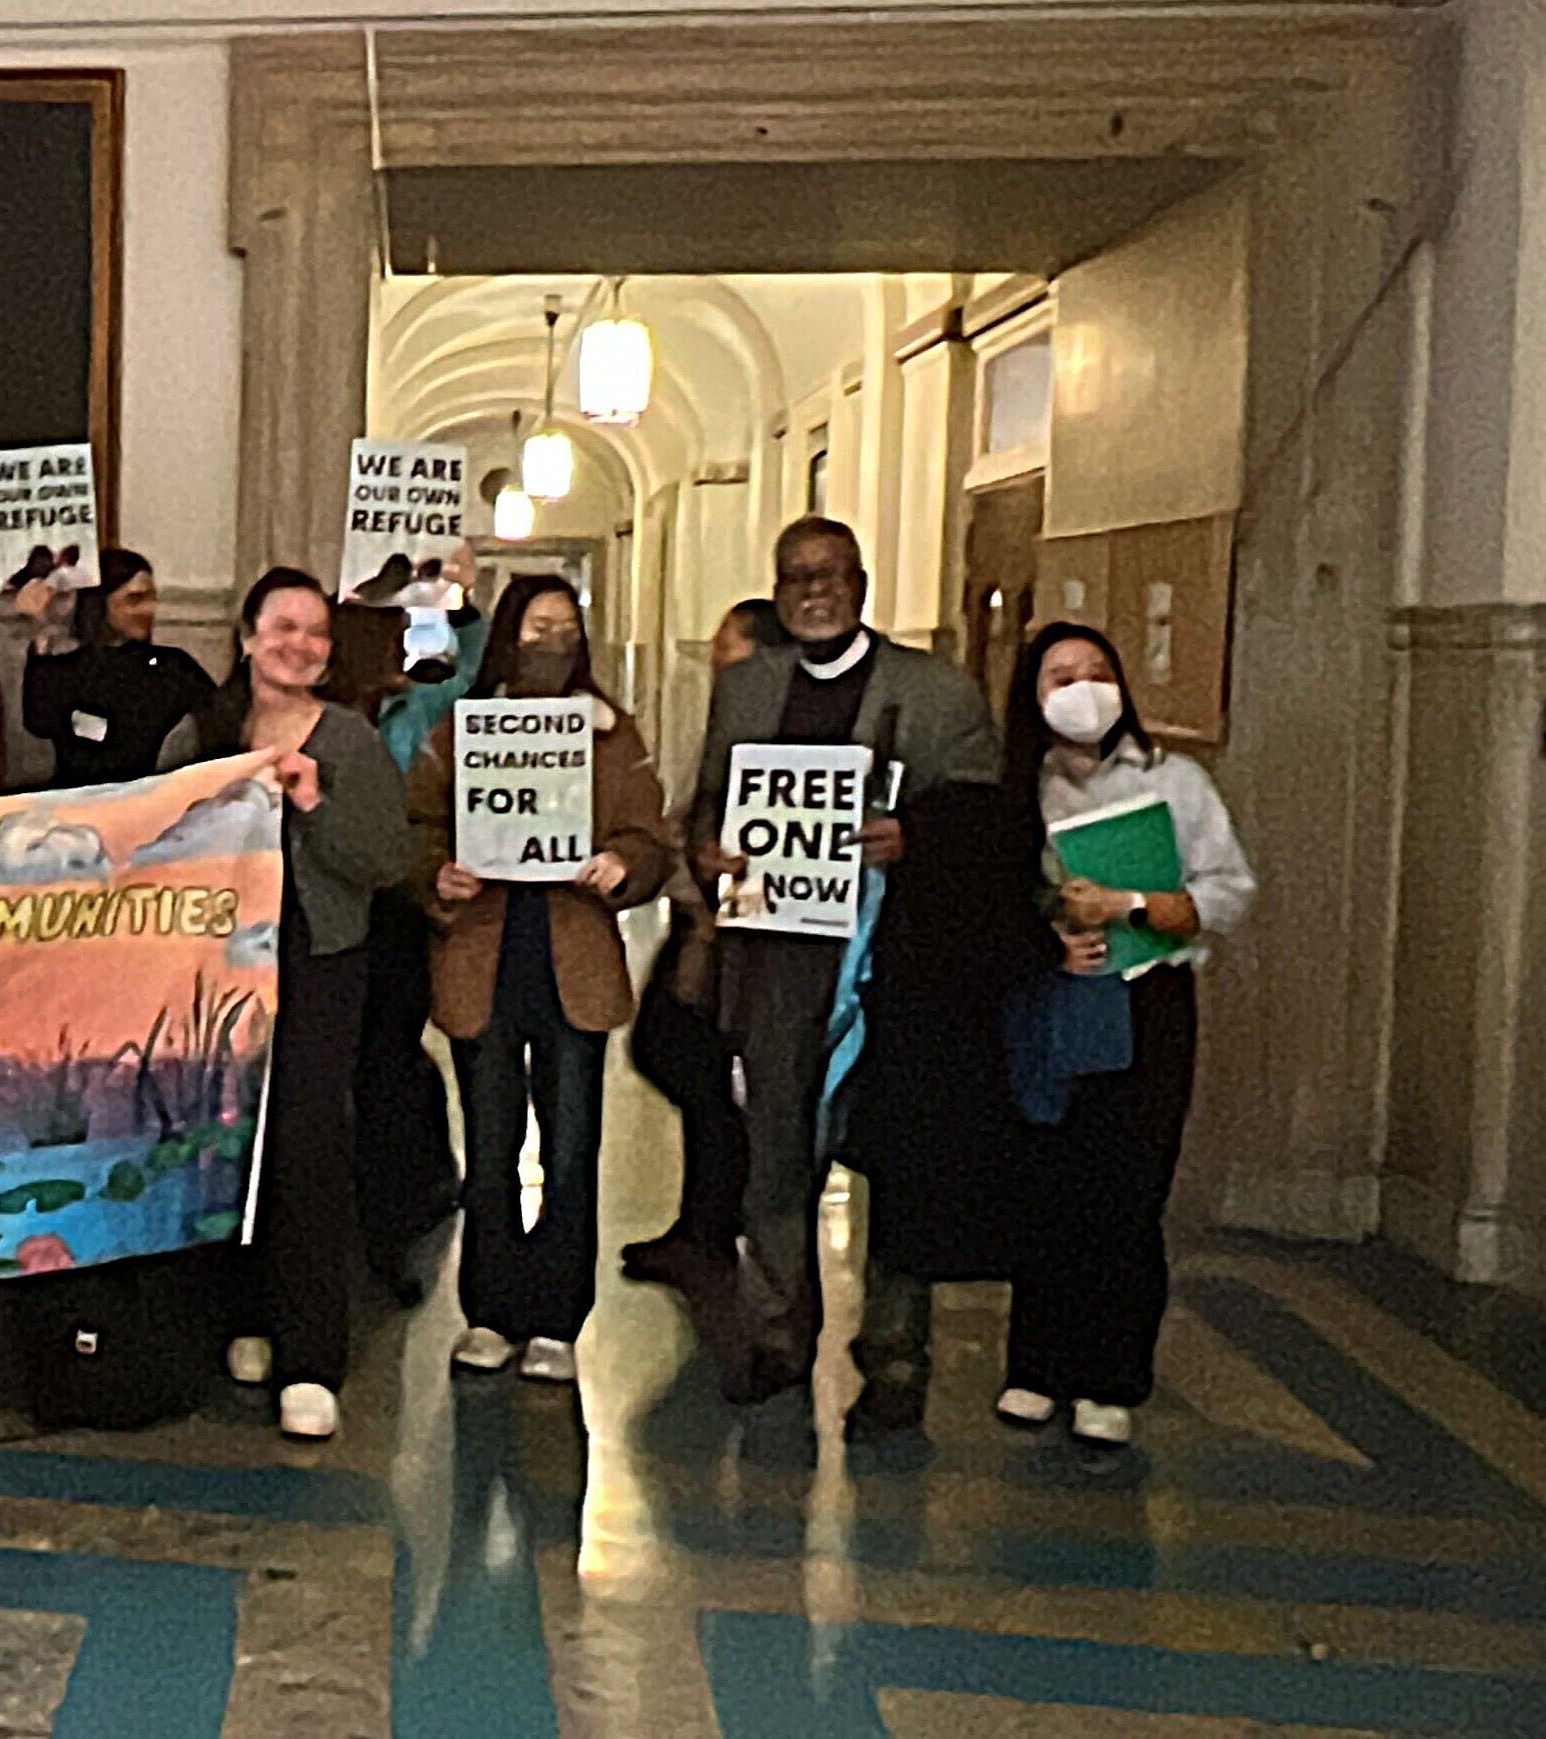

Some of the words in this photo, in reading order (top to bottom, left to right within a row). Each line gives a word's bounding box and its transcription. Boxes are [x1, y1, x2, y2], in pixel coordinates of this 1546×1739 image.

[39, 457, 86, 480] ARE
[357, 455, 401, 477] WE
[411, 458, 462, 481] ARE
[355, 485, 401, 502] OUR
[351, 509, 462, 536] REFUGE
[465, 713, 584, 735] SECOND
[464, 750, 586, 769] CHANCES
[468, 787, 539, 814] FOR
[739, 768, 855, 810] FREE
[520, 835, 583, 863] ALL
[739, 818, 855, 861] ONE
[763, 872, 852, 903] NOW
